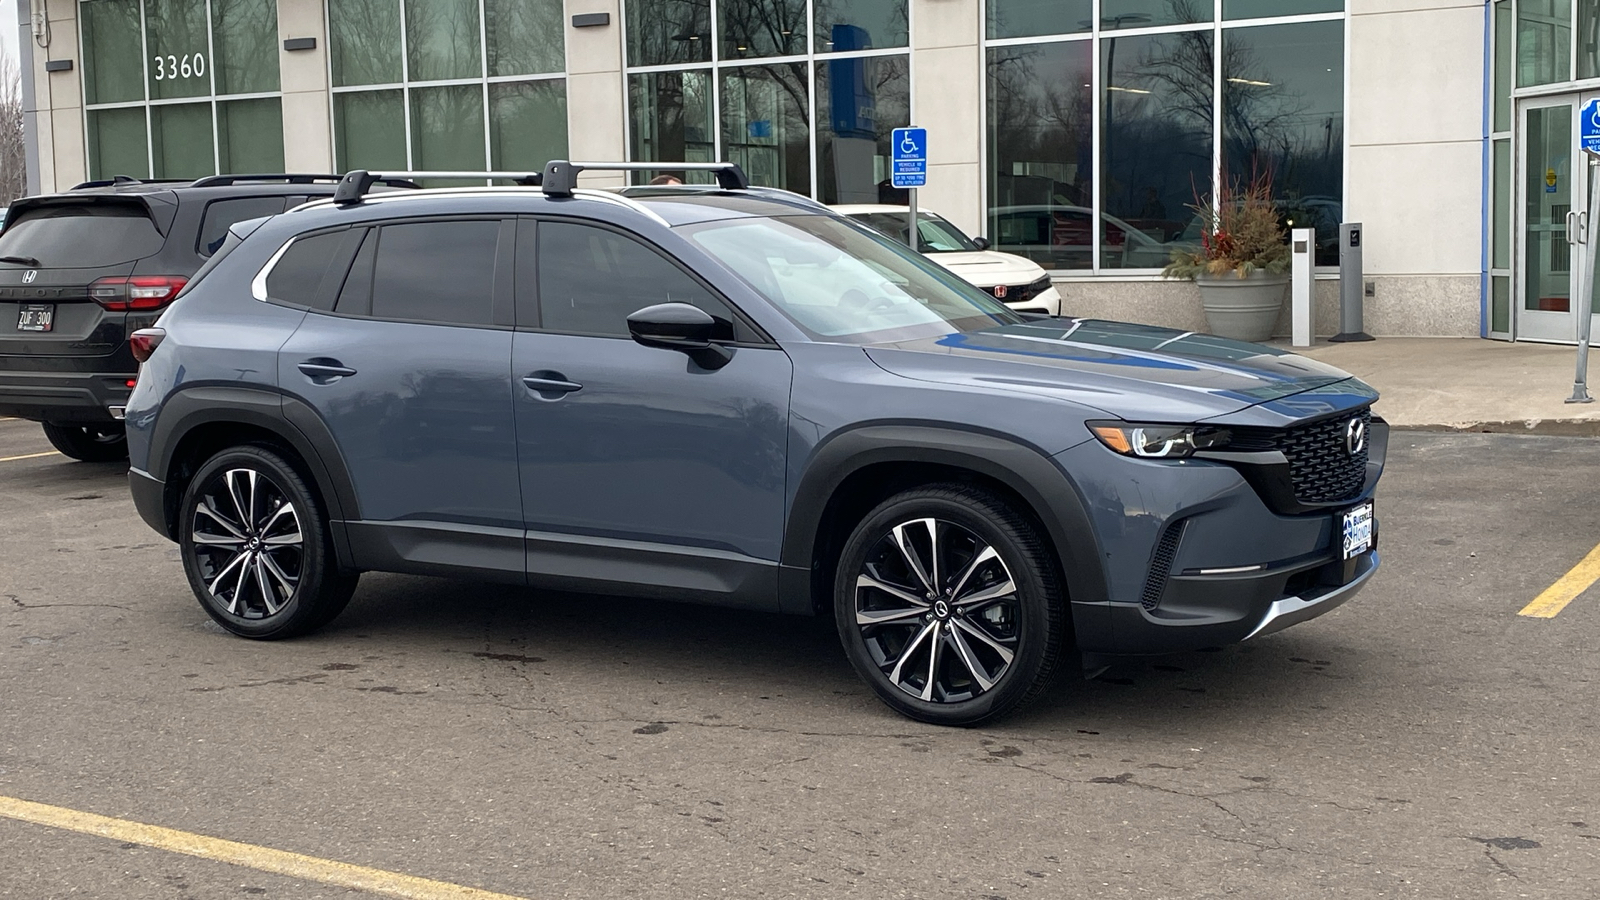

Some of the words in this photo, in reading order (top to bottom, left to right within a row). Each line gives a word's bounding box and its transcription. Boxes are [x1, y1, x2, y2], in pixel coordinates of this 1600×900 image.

[154, 52, 205, 80] 3360
[0, 288, 64, 298] ILOT
[19, 311, 34, 325] ZUF
[36, 311, 51, 325] 300
[1353, 524, 1371, 543] HONDA
